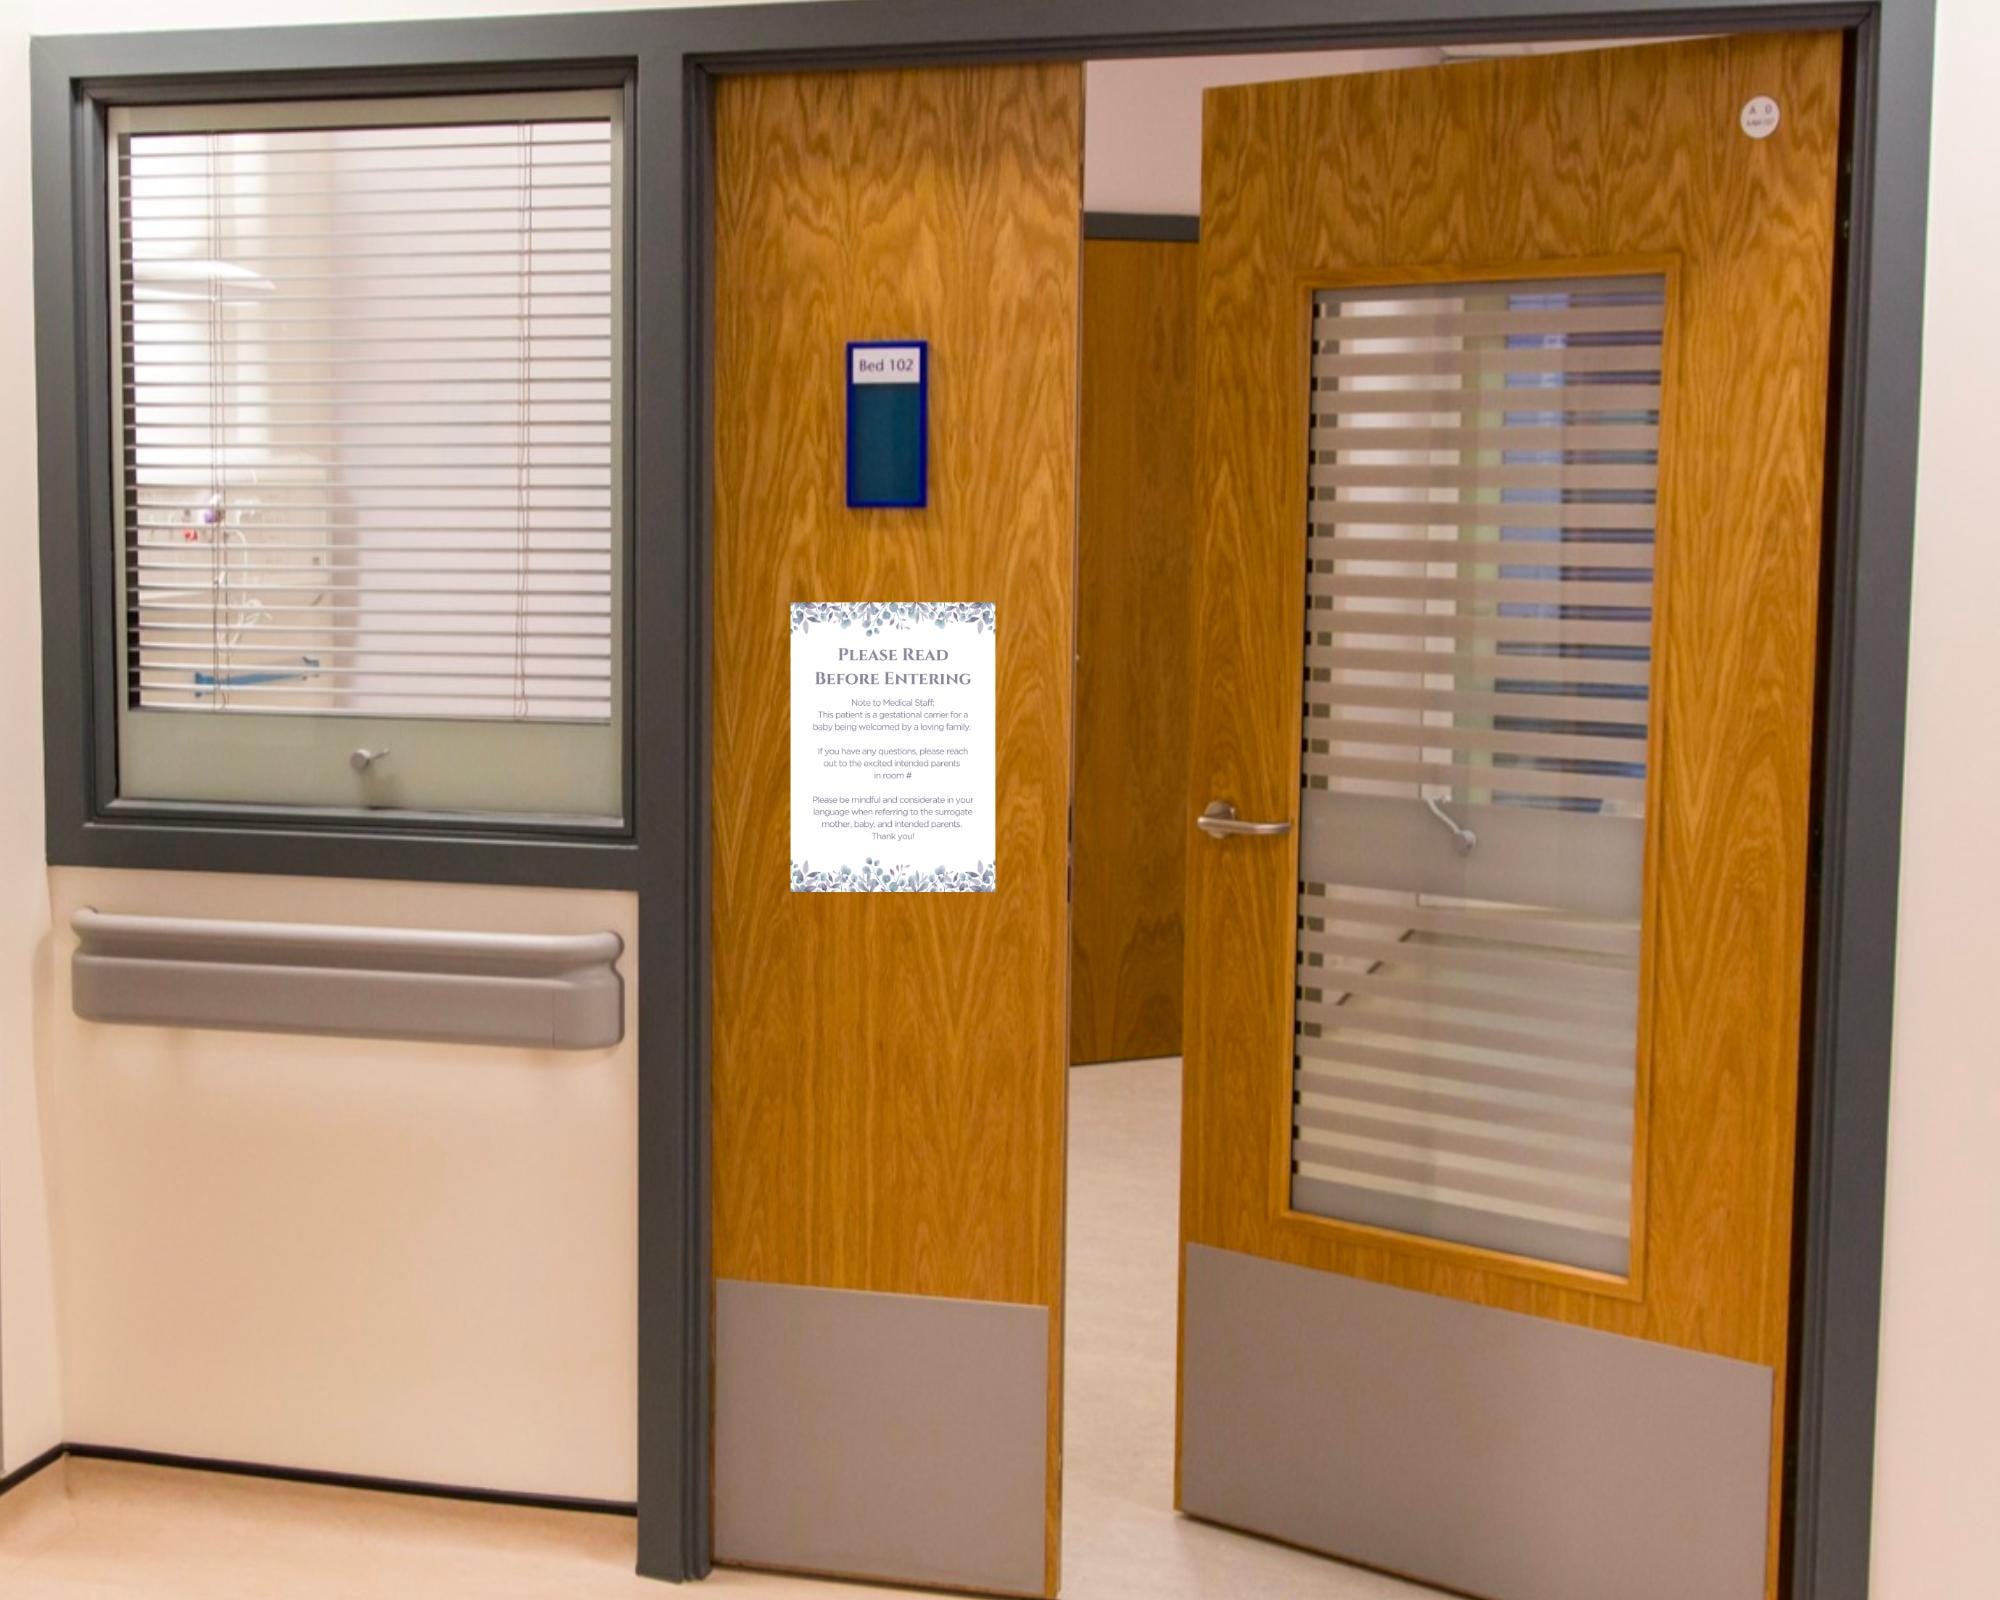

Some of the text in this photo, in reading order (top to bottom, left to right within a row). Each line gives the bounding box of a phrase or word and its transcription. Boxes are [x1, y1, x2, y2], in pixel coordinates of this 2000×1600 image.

[859, 358, 914, 372] Bed 102
[851, 699, 871, 707] Note
[872, 699, 881, 707] to
[883, 699, 912, 707] Medical
[818, 711, 834, 719] This
[836, 711, 863, 721] patient
[865, 711, 871, 719] is
[879, 711, 922, 721] gestational
[950, 711, 962, 719] for
[813, 723, 833, 732] baby
[835, 723, 857, 732] being
[858, 723, 900, 731] welcomed
[902, 723, 911, 732] by
[921, 723, 944, 732] loving
[817, 747, 969, 757] If you have any questions, please reach
[930, 760, 960, 769] parents
[874, 772, 881, 780] in
[906, 772, 912, 780] #
[813, 796, 838, 804] Please
[839, 796, 849, 804] be
[852, 796, 881, 804] mindful
[882, 796, 898, 804] and
[899, 796, 945, 804] considerate
[947, 796, 954, 804] in
[813, 808, 973, 817] language when referring to the surrogate
[822, 820, 852, 829] mother,
[854, 820, 876, 830] baby,
[877, 820, 892, 828] and
[894, 820, 929, 828] intended
[872, 832, 915, 842] Thank you!
